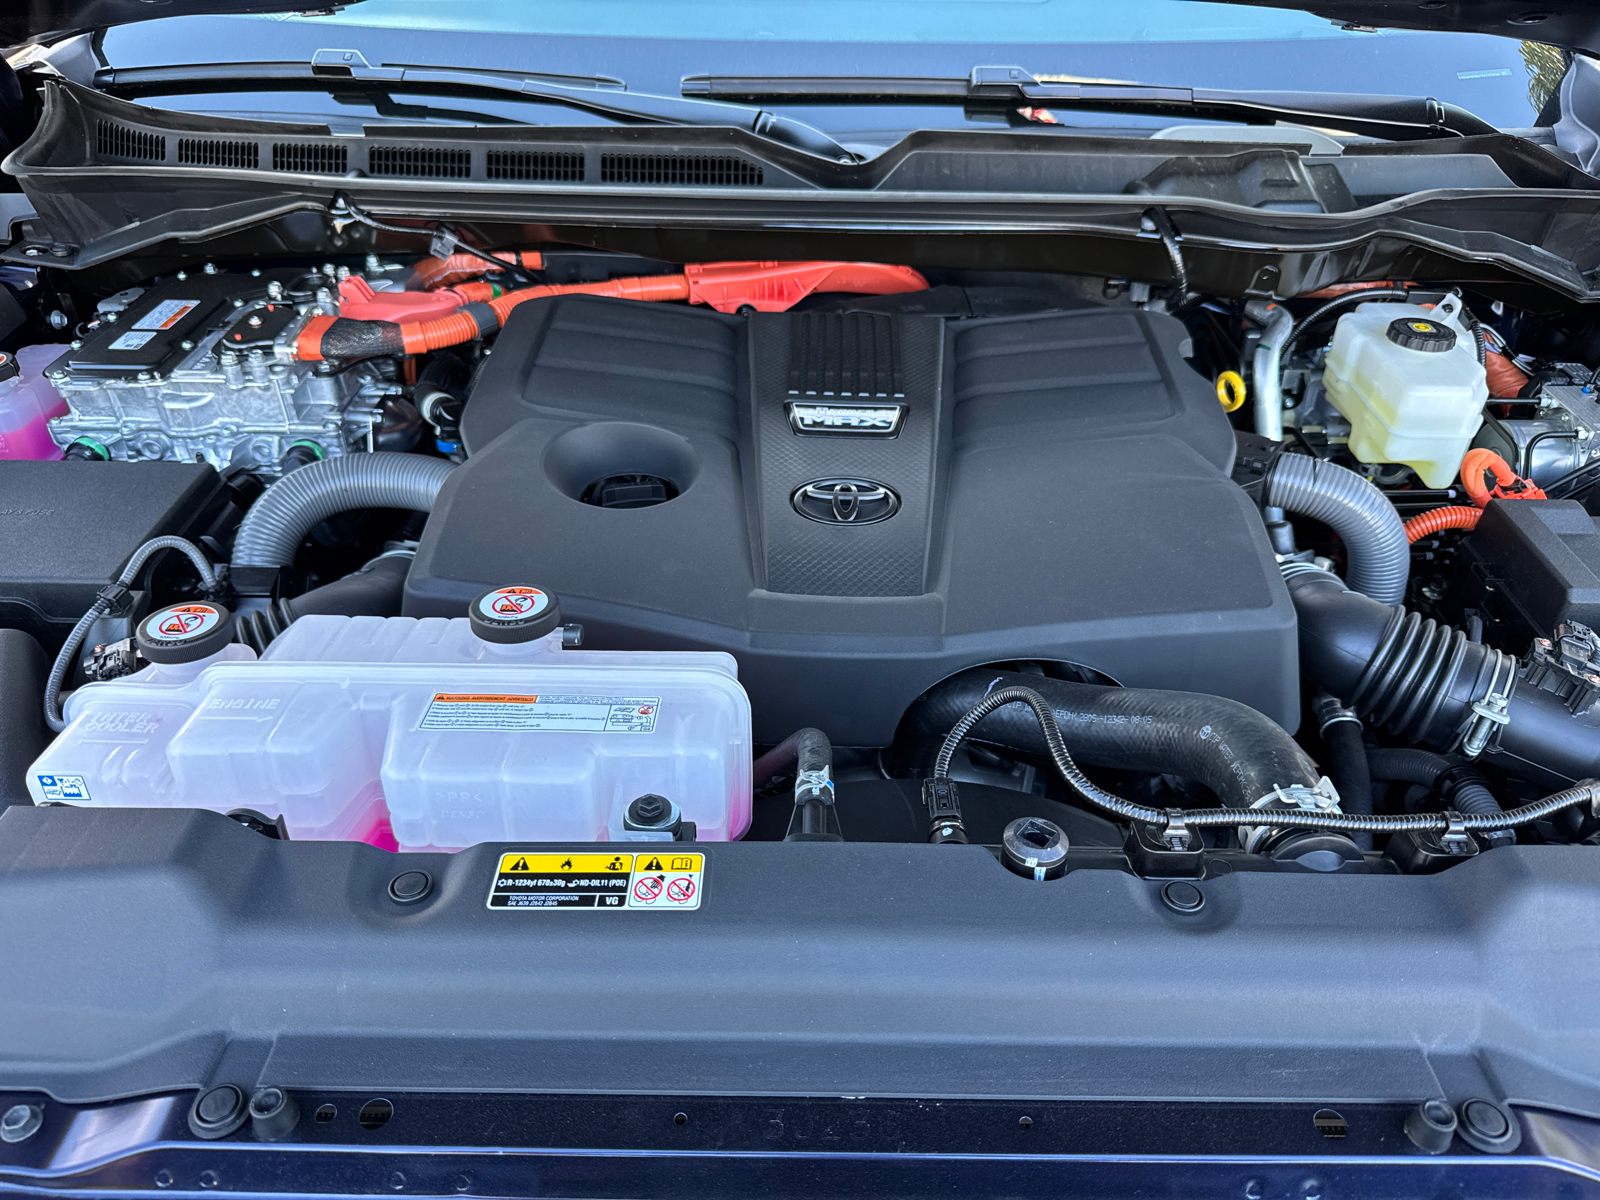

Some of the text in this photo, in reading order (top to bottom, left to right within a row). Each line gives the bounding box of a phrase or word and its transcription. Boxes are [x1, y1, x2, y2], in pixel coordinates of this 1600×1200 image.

[803, 415, 890, 427] MAX
[208, 698, 281, 710] ENGINE
[90, 711, 153, 722] INTER
[85, 722, 160, 733] COOLER
[440, 810, 485, 819] DENSO
[507, 879, 537, 887] R-1234yf
[608, 879, 627, 888] (POE)
[605, 896, 619, 905] VG
